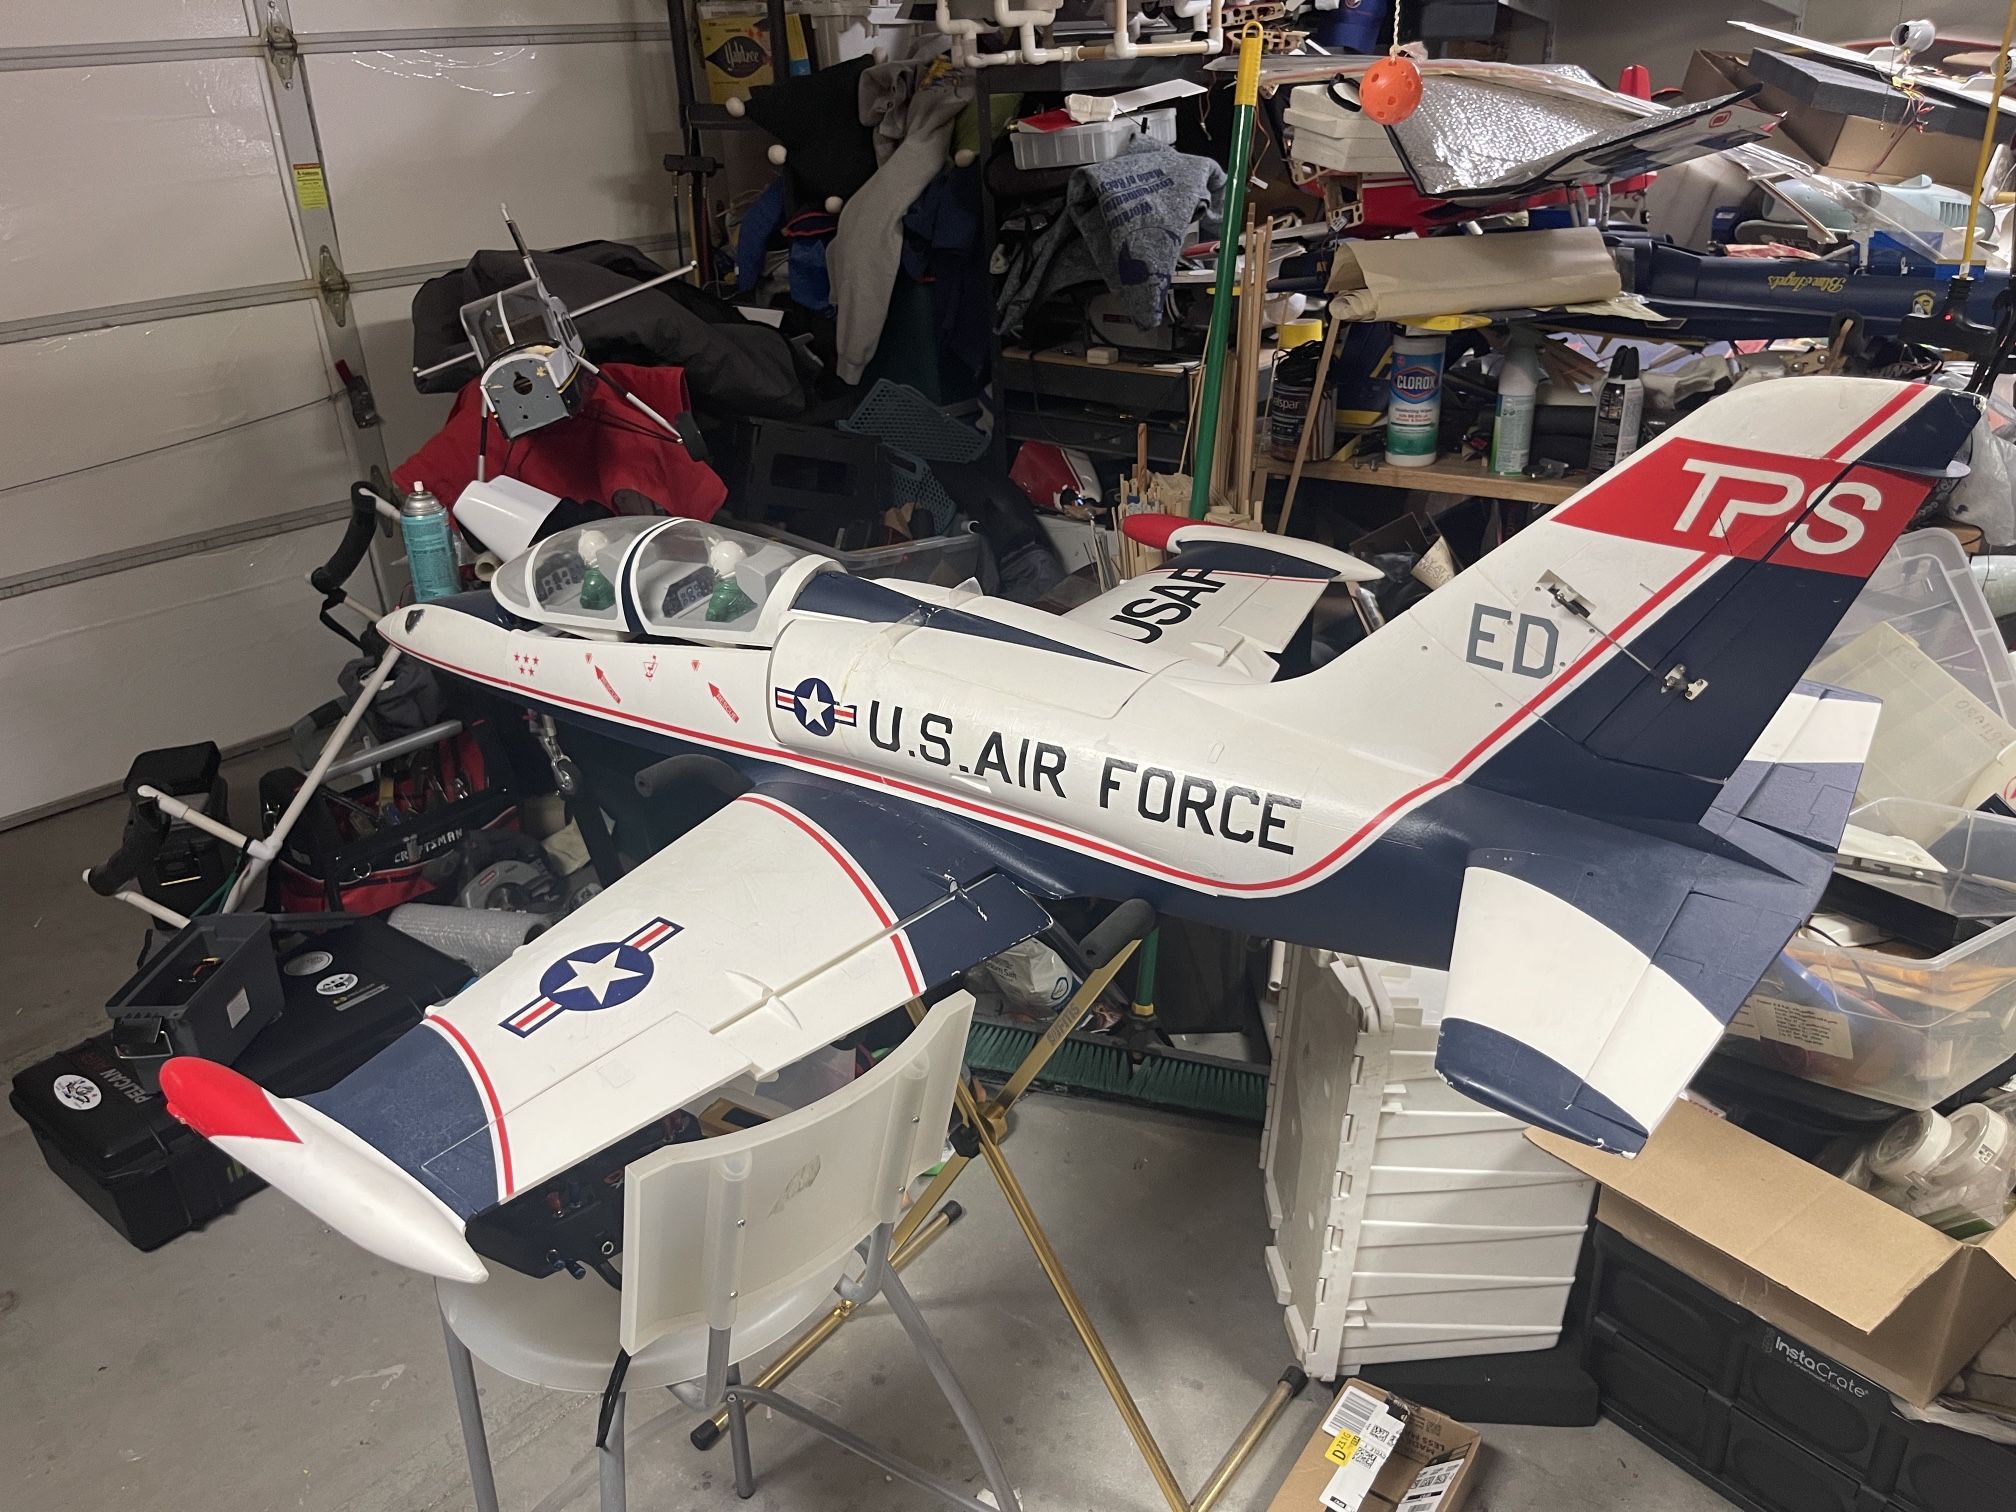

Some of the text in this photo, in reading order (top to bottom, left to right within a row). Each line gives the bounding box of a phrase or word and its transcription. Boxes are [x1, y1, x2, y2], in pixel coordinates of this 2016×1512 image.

[1767, 271, 1846, 293] Blue Angels
[1397, 374, 1436, 390] CLOROX
[1673, 458, 1882, 555] TPS
[1466, 603, 1559, 680] ED
[716, 692, 737, 722] RESCUE
[1099, 757, 1303, 855] FORCE
[394, 828, 463, 863] CRTSMAN
[100, 1068, 153, 1104] PELICAN
[1332, 1449, 1346, 1460] D
